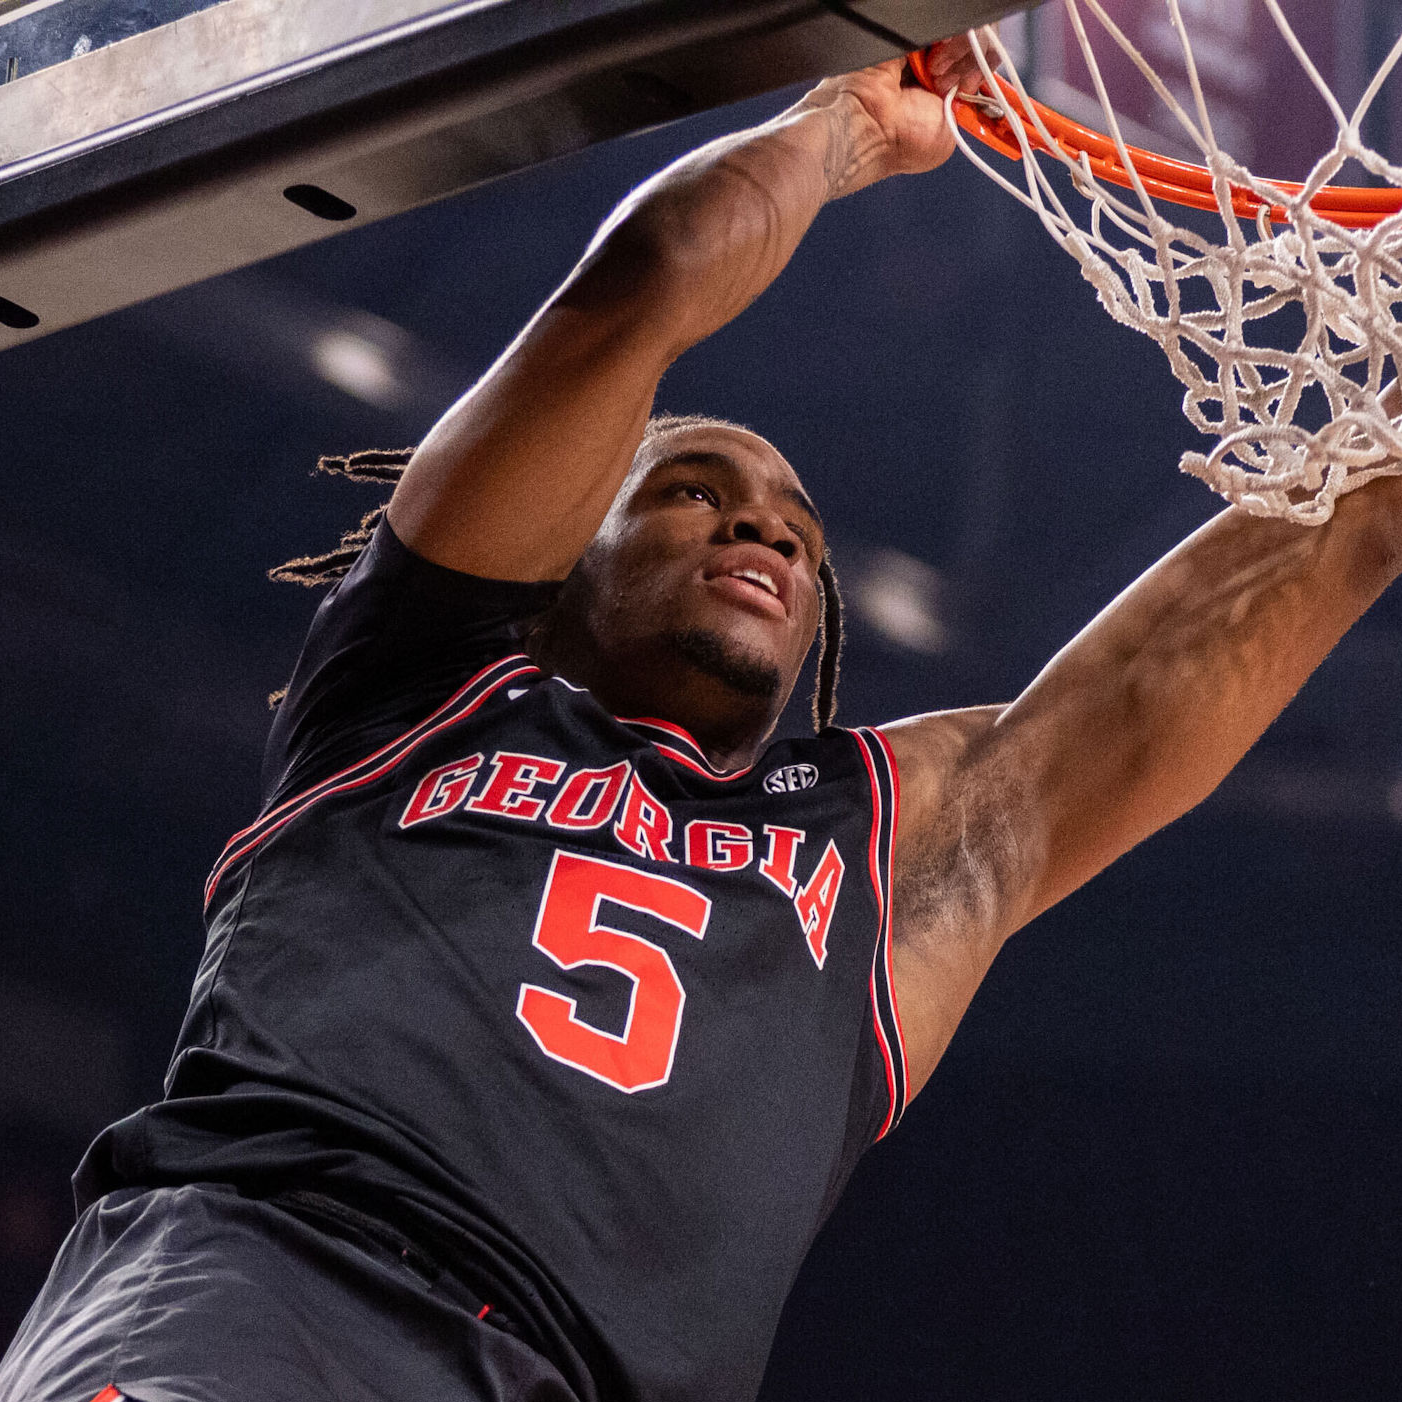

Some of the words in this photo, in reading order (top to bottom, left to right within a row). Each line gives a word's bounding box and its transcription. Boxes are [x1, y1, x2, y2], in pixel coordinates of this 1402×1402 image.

[398, 750, 846, 971] GEORGIA
[767, 765, 815, 794] SEC
[516, 848, 713, 1094] 5
